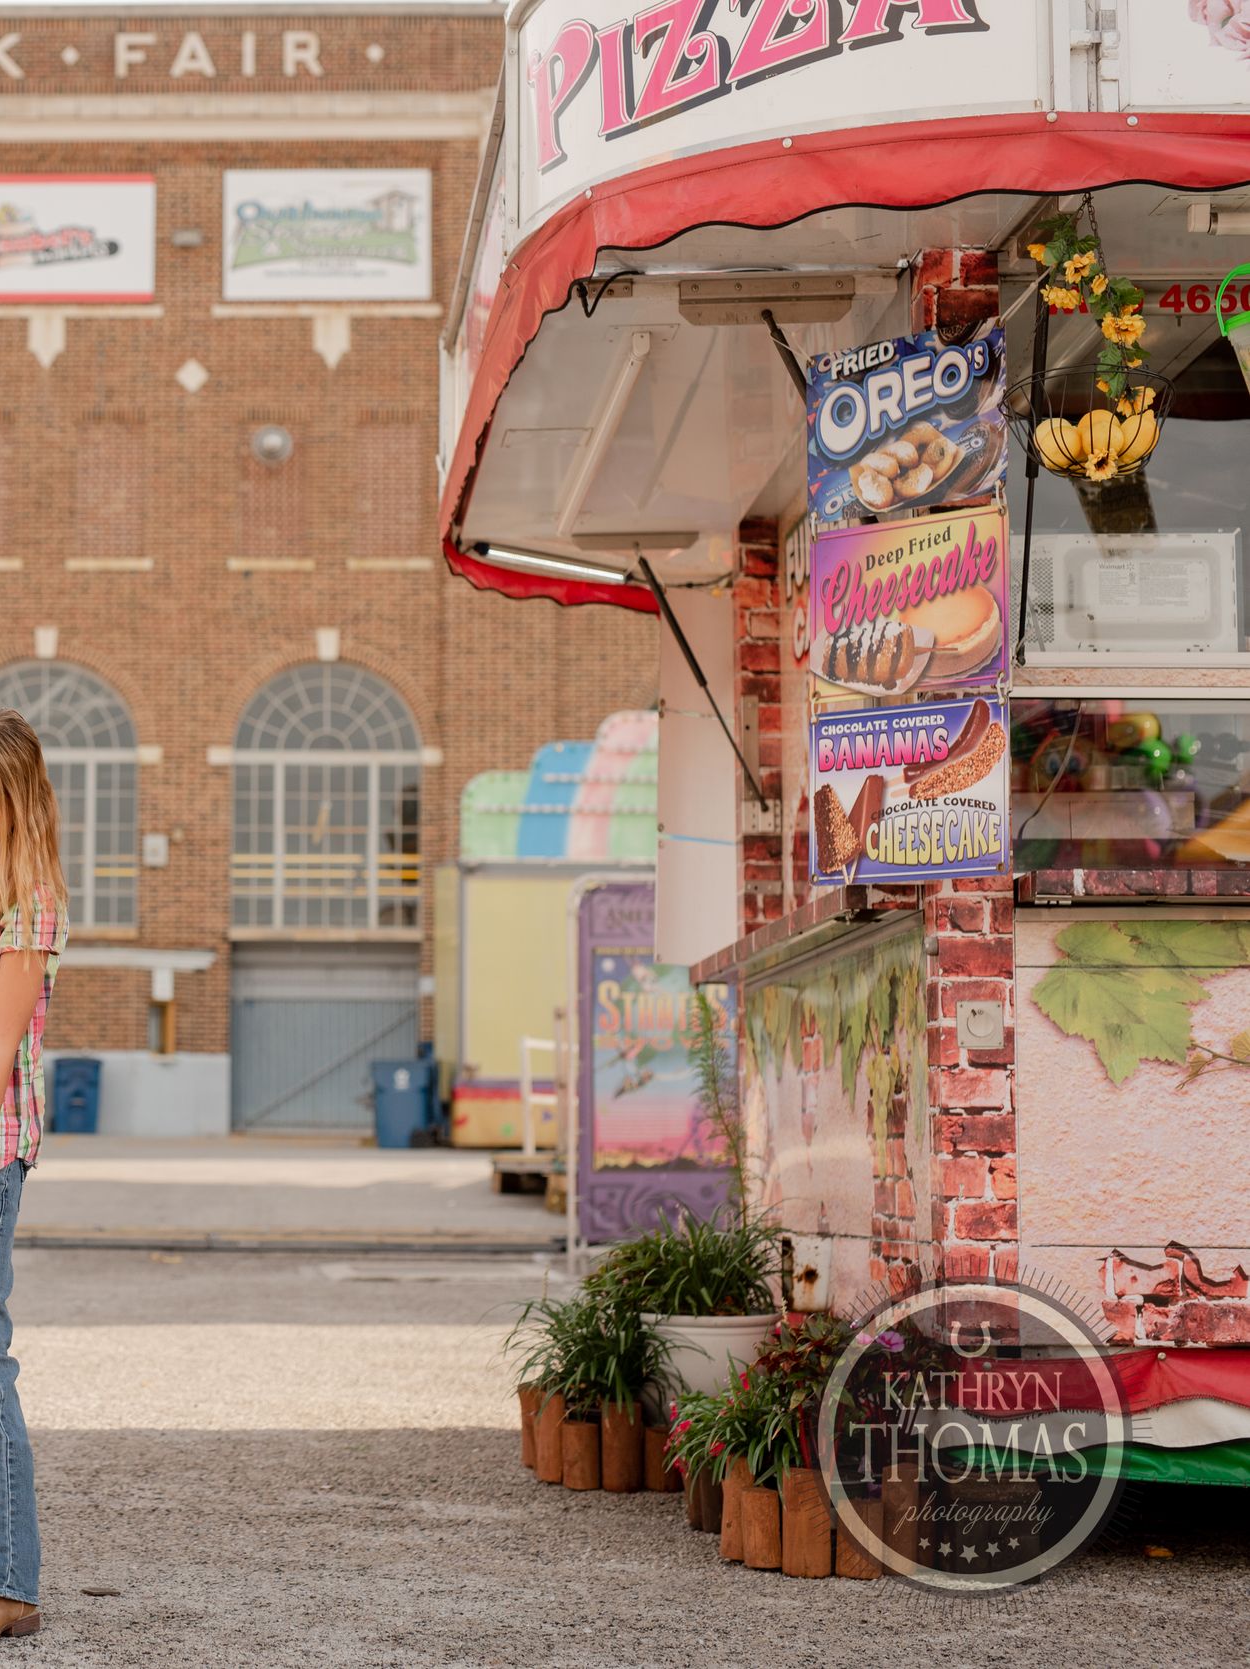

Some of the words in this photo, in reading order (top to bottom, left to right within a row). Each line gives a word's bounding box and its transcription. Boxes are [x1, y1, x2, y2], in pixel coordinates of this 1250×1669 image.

[114, 29, 324, 80] FAIR
[831, 341, 895, 380] FRIED
[818, 344, 986, 454] OREO'S
[864, 547, 904, 571] Deep
[908, 526, 952, 557] Fried
[820, 519, 997, 635] Cheesecake
[821, 719, 888, 736] CHOCOLATE
[892, 714, 945, 729] COVERED
[817, 727, 951, 773] BANANAS
[870, 797, 939, 821] CHOCOLATE
[943, 797, 997, 812] COVERED
[865, 810, 1002, 866] CHEESECAKE
